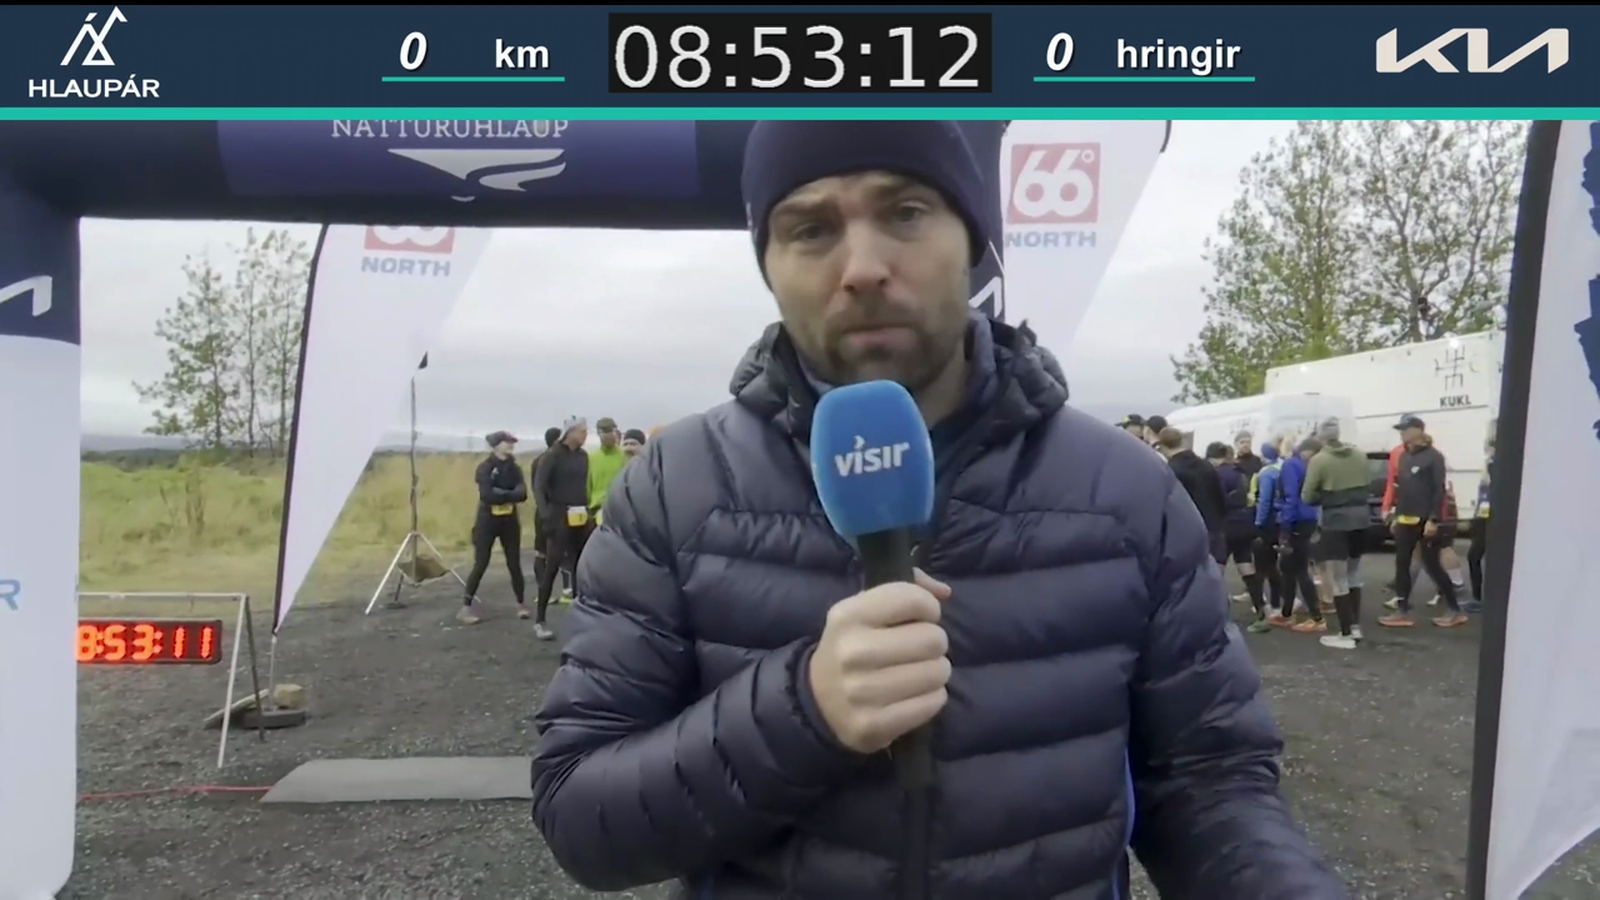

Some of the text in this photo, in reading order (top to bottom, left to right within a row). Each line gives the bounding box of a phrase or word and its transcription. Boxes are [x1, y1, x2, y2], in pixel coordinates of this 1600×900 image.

[1004, 230, 1097, 248] NORTH
[361, 256, 451, 277] NORTH
[1439, 395, 1472, 408] KUKL
